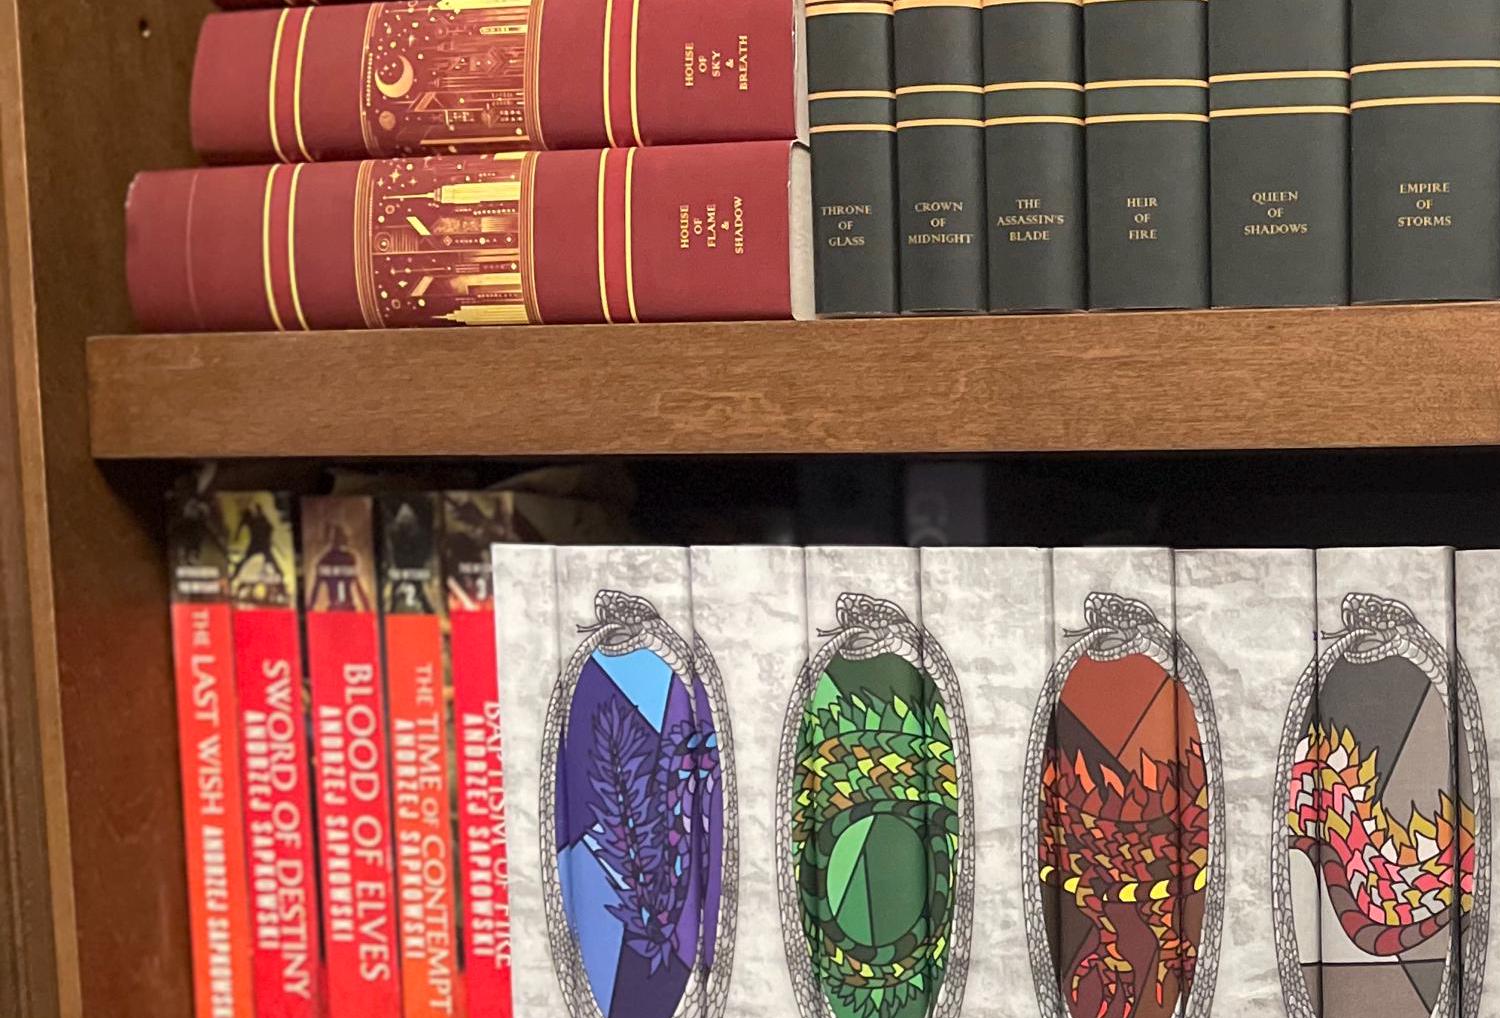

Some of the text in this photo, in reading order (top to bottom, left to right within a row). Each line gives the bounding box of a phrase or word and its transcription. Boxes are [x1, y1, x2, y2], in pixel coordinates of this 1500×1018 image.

[684, 42, 695, 87] HOUSE
[698, 55, 708, 73] OF
[711, 50, 721, 78] SKY
[724, 58, 734, 69] &
[738, 35, 748, 91] BREATH
[1399, 182, 1451, 195] EMPIRE
[1126, 196, 1159, 208] HEIR
[1251, 191, 1299, 204] QUEEN
[821, 204, 872, 216] THRONE
[914, 201, 964, 213] CROWN
[1015, 199, 1041, 210] THE
[1415, 199, 1434, 210] OF
[1134, 213, 1151, 224] OF
[1267, 207, 1285, 219] OF
[693, 218, 703, 235] OF
[707, 204, 717, 249] FLAME
[720, 220, 730, 231] &
[734, 196, 744, 255] SHADOW
[838, 220, 854, 231] OF
[930, 217, 947, 228] OF
[996, 214, 1066, 226] ASSASSIN'S
[1397, 215, 1452, 227] STORMS
[680, 205, 690, 249] HOUSE
[1243, 223, 1309, 236] SHADOWS
[828, 236, 865, 247] GLASS
[908, 233, 974, 245] MIDNIGHT
[1009, 230, 1050, 242] BLADE
[1128, 229, 1159, 241] FIRE
[192, 611, 209, 646] THE
[191, 655, 219, 727] LAST
[197, 735, 225, 816] WISH
[263, 659, 310, 1000] SWORD OF DESTINY
[319, 705, 354, 942] ANDRZEJ SAPKOWSKI
[343, 664, 391, 982] BLOOD OF ELVES
[244, 711, 280, 950] ANDRZEJ SAPKOWSKI
[463, 713, 494, 957] ANDRZEJ SAPKOWSKI
[394, 719, 426, 959] ANDRZEJ SAPKOWSKI
[416, 663, 453, 1015] THE TIME OF CONTEMPT
